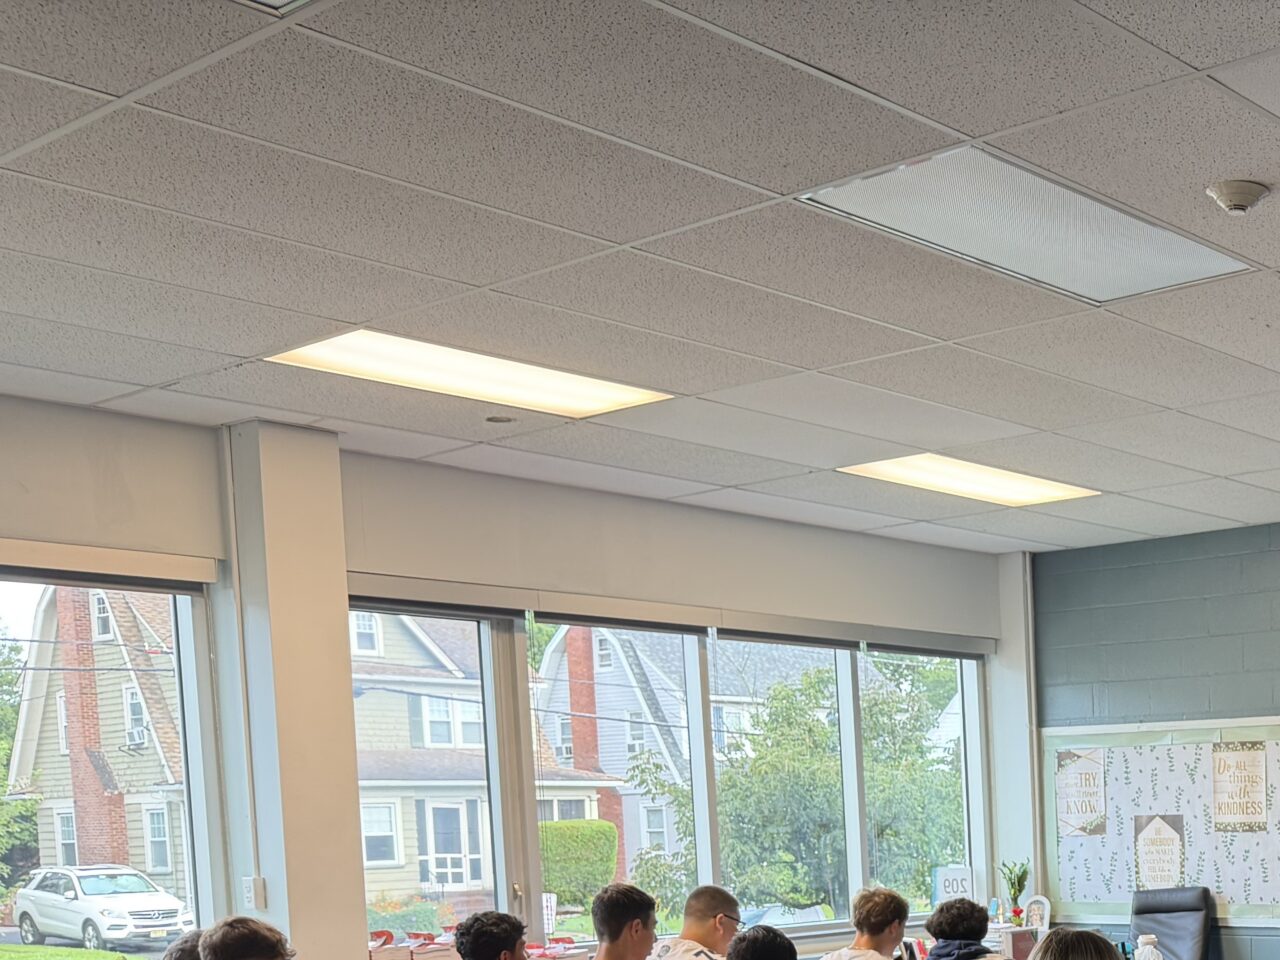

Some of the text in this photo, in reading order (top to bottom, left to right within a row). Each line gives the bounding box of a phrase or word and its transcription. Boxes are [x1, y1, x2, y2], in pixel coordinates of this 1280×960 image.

[1235, 760, 1248, 771] ALL
[1229, 771, 1264, 787] things
[1066, 799, 1098, 815] KNOW
[1217, 801, 1263, 816] KINDNESS
